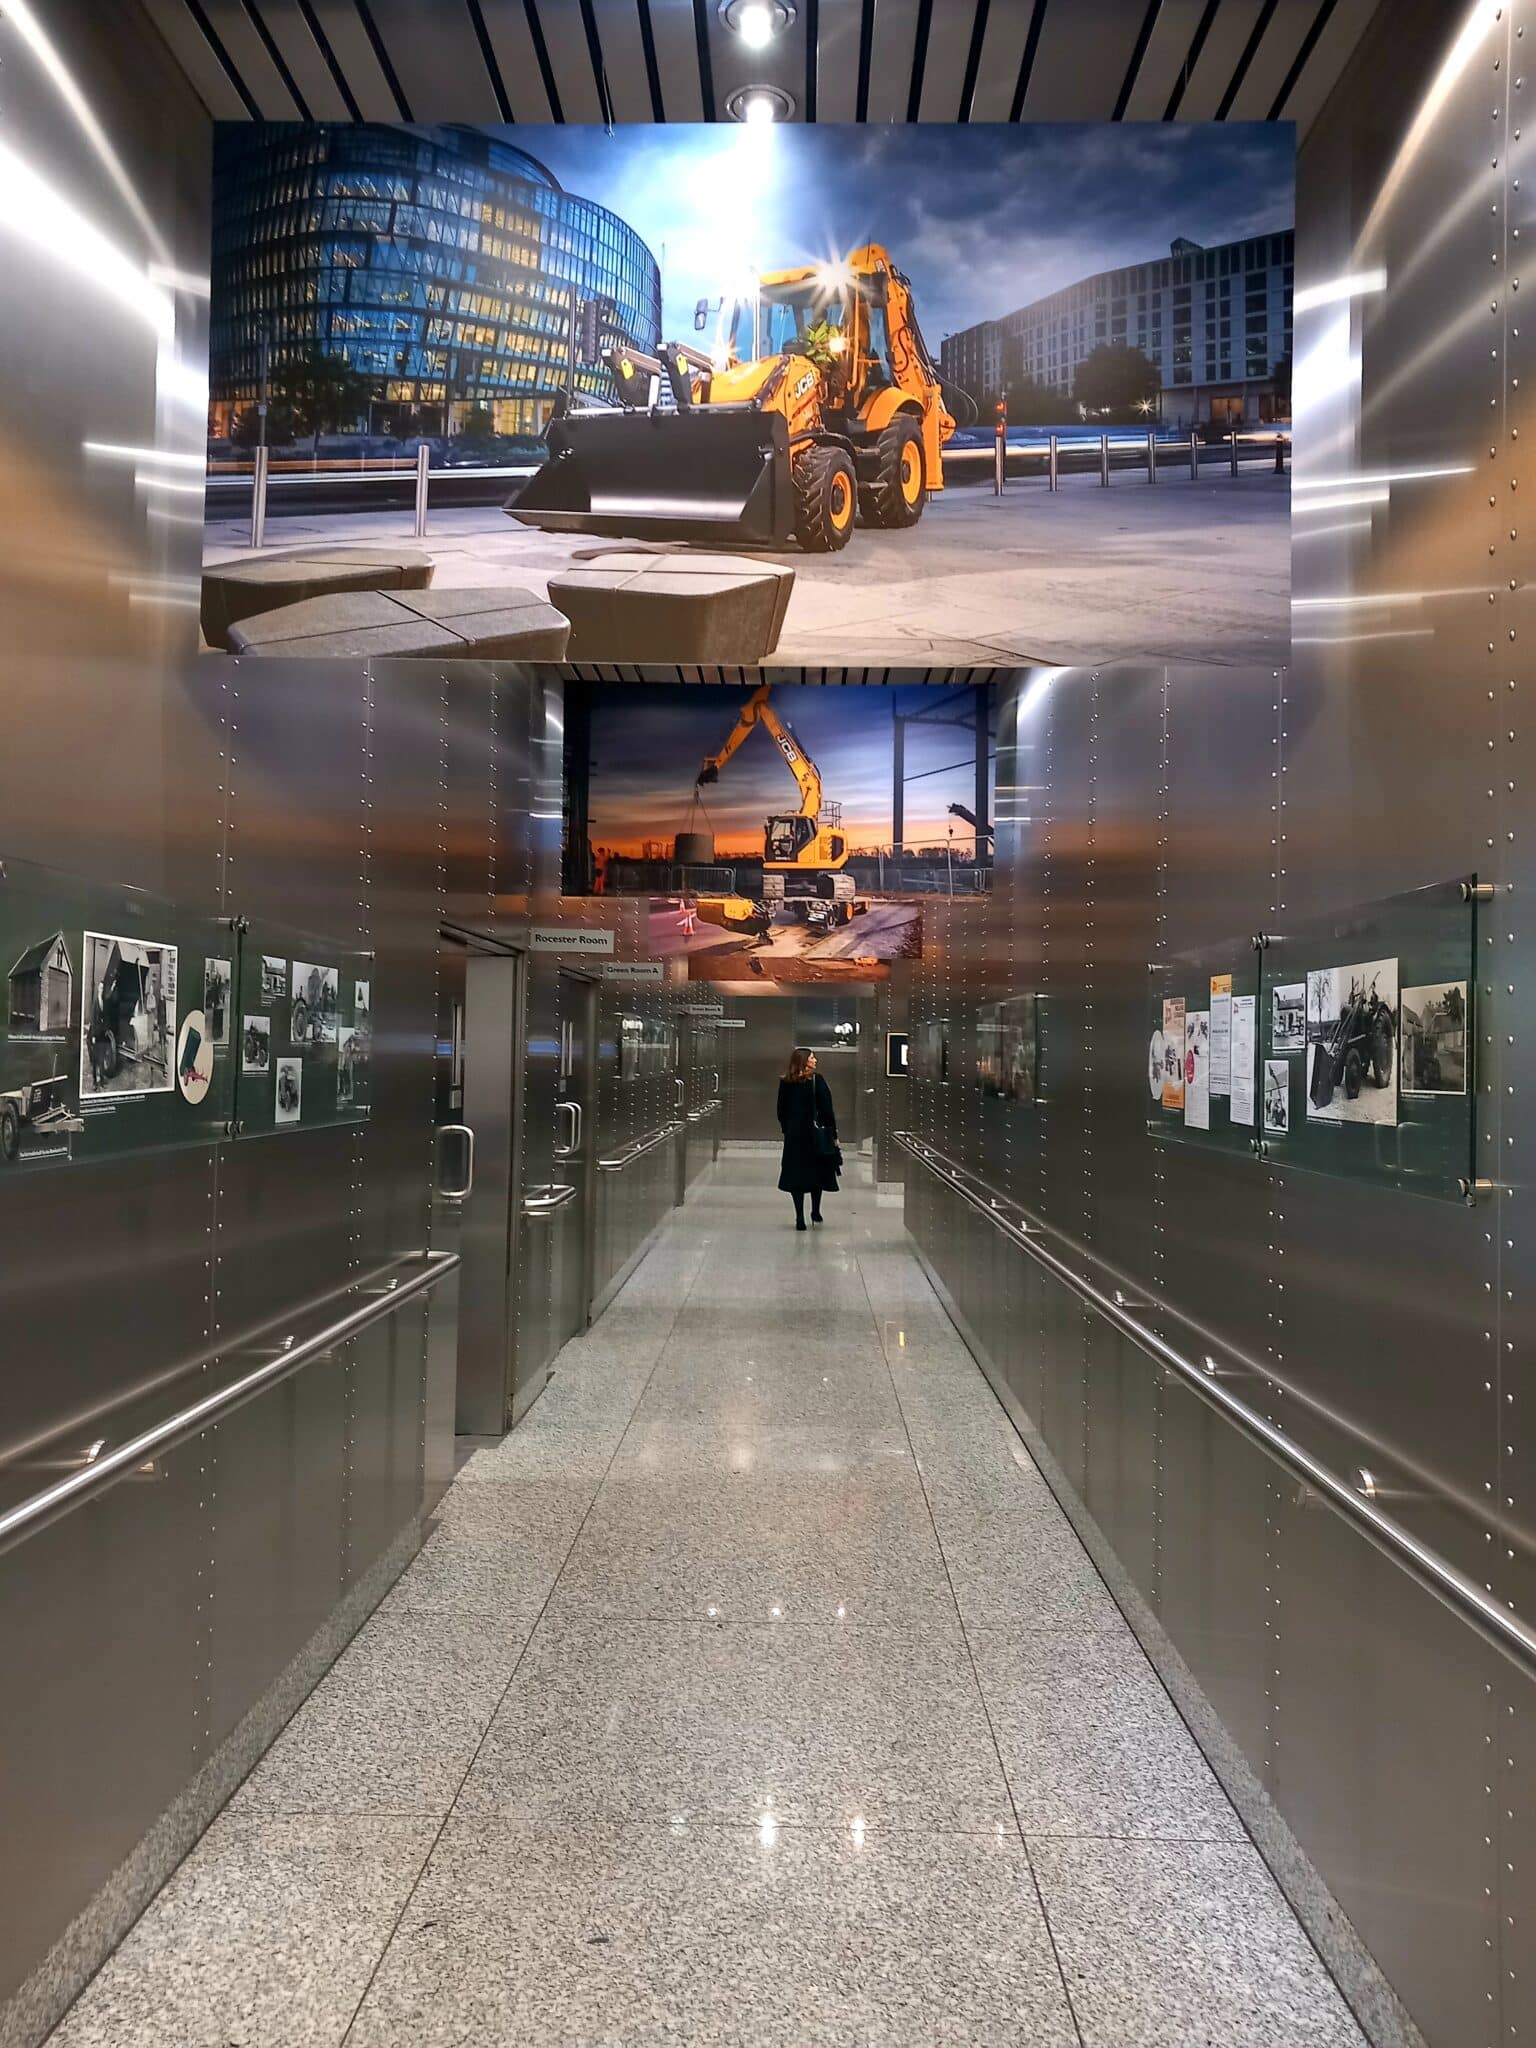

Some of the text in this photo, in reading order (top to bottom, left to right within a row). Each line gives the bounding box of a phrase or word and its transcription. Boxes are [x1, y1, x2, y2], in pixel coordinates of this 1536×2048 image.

[795, 371, 814, 400] JCB
[776, 735, 797, 762] JCB
[535, 934, 608, 945] Rocester Room
[607, 966, 630, 974] Green
